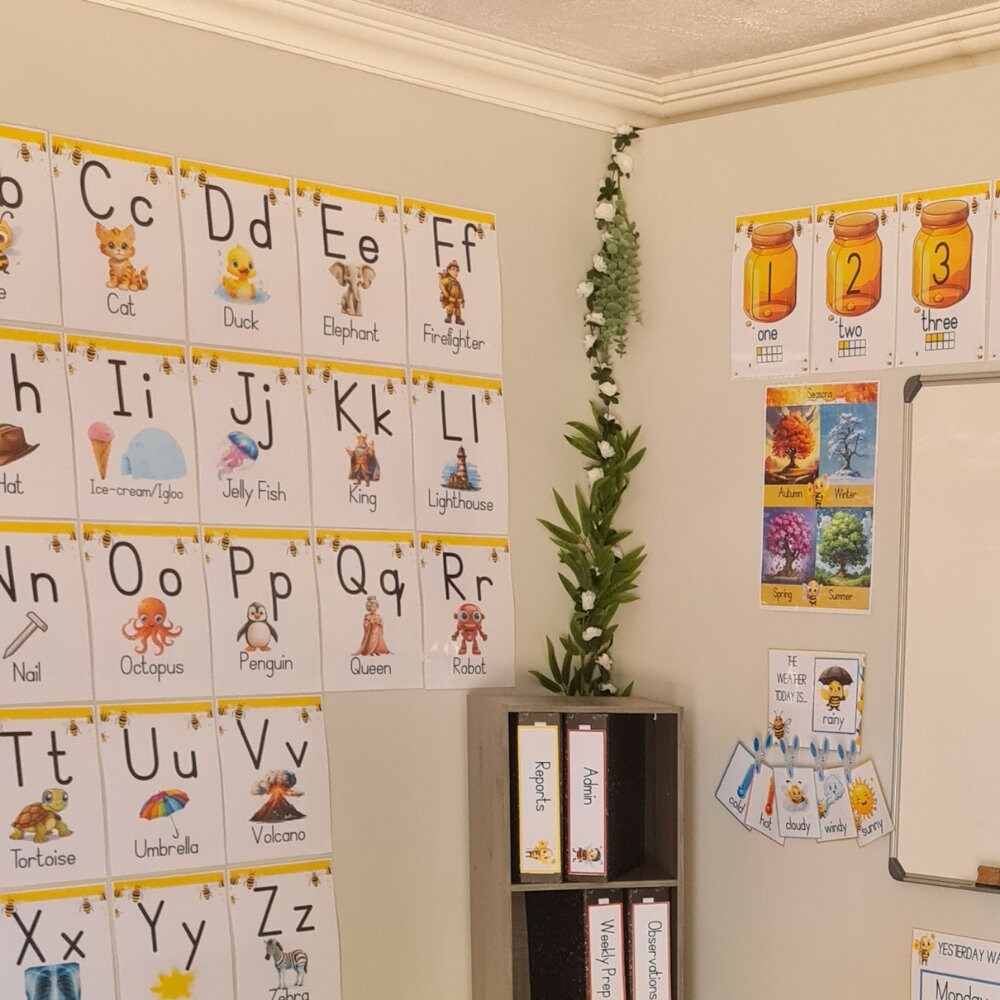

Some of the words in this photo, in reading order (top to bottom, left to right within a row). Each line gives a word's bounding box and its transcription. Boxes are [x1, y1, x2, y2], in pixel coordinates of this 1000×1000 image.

[80, 160, 154, 228] Cc
[321, 202, 379, 264] Ee
[847, 252, 861, 295] 2
[933, 242, 950, 285] 3
[107, 292, 136, 316] Cat
[224, 306, 259, 330] Duck
[838, 318, 862, 338] two
[922, 309, 958, 332] three
[324, 315, 380, 345] Elephant
[424, 324, 485, 354] Firefighter
[758, 329, 778, 341] one
[807, 388, 833, 399] Seasons
[228, 372, 273, 451] Jj
[334, 380, 394, 436] Kk
[90, 478, 184, 504] Ice-cream/Igloo
[222, 478, 254, 507] Jelly
[258, 480, 286, 501] Fish
[350, 485, 377, 512] King
[429, 488, 493, 515] Lighthouse
[778, 488, 803, 498] Autumn
[834, 488, 857, 499] Winter
[229, 546, 292, 621] Pp
[443, 552, 493, 601] Rr
[773, 590, 792, 602] Spring
[828, 590, 853, 600] Summer
[13, 662, 41, 682] Nail
[120, 655, 184, 682] Octopus
[240, 651, 293, 678] Penguin
[350, 657, 391, 675] Queen
[453, 657, 486, 674] Robot
[788, 656, 797, 667] THE
[777, 673, 807, 685] WEATHER
[774, 690, 794, 702] TODAY
[823, 713, 844, 731] rainy
[529, 762, 551, 811] Reports
[583, 767, 598, 805] Admin
[729, 797, 746, 814] cold
[252, 825, 306, 844] Volcano
[760, 817, 772, 831] hot
[786, 820, 810, 836] cloudy
[824, 818, 847, 836] windy
[862, 820, 883, 836] sunny
[10, 848, 76, 868] Tortoise
[135, 836, 198, 858] Umbrella
[596, 919, 616, 964] Weekly
[938, 942, 984, 962] YESTERDAY
[648, 921, 663, 1000] Observations
[597, 968, 616, 998] Prep
